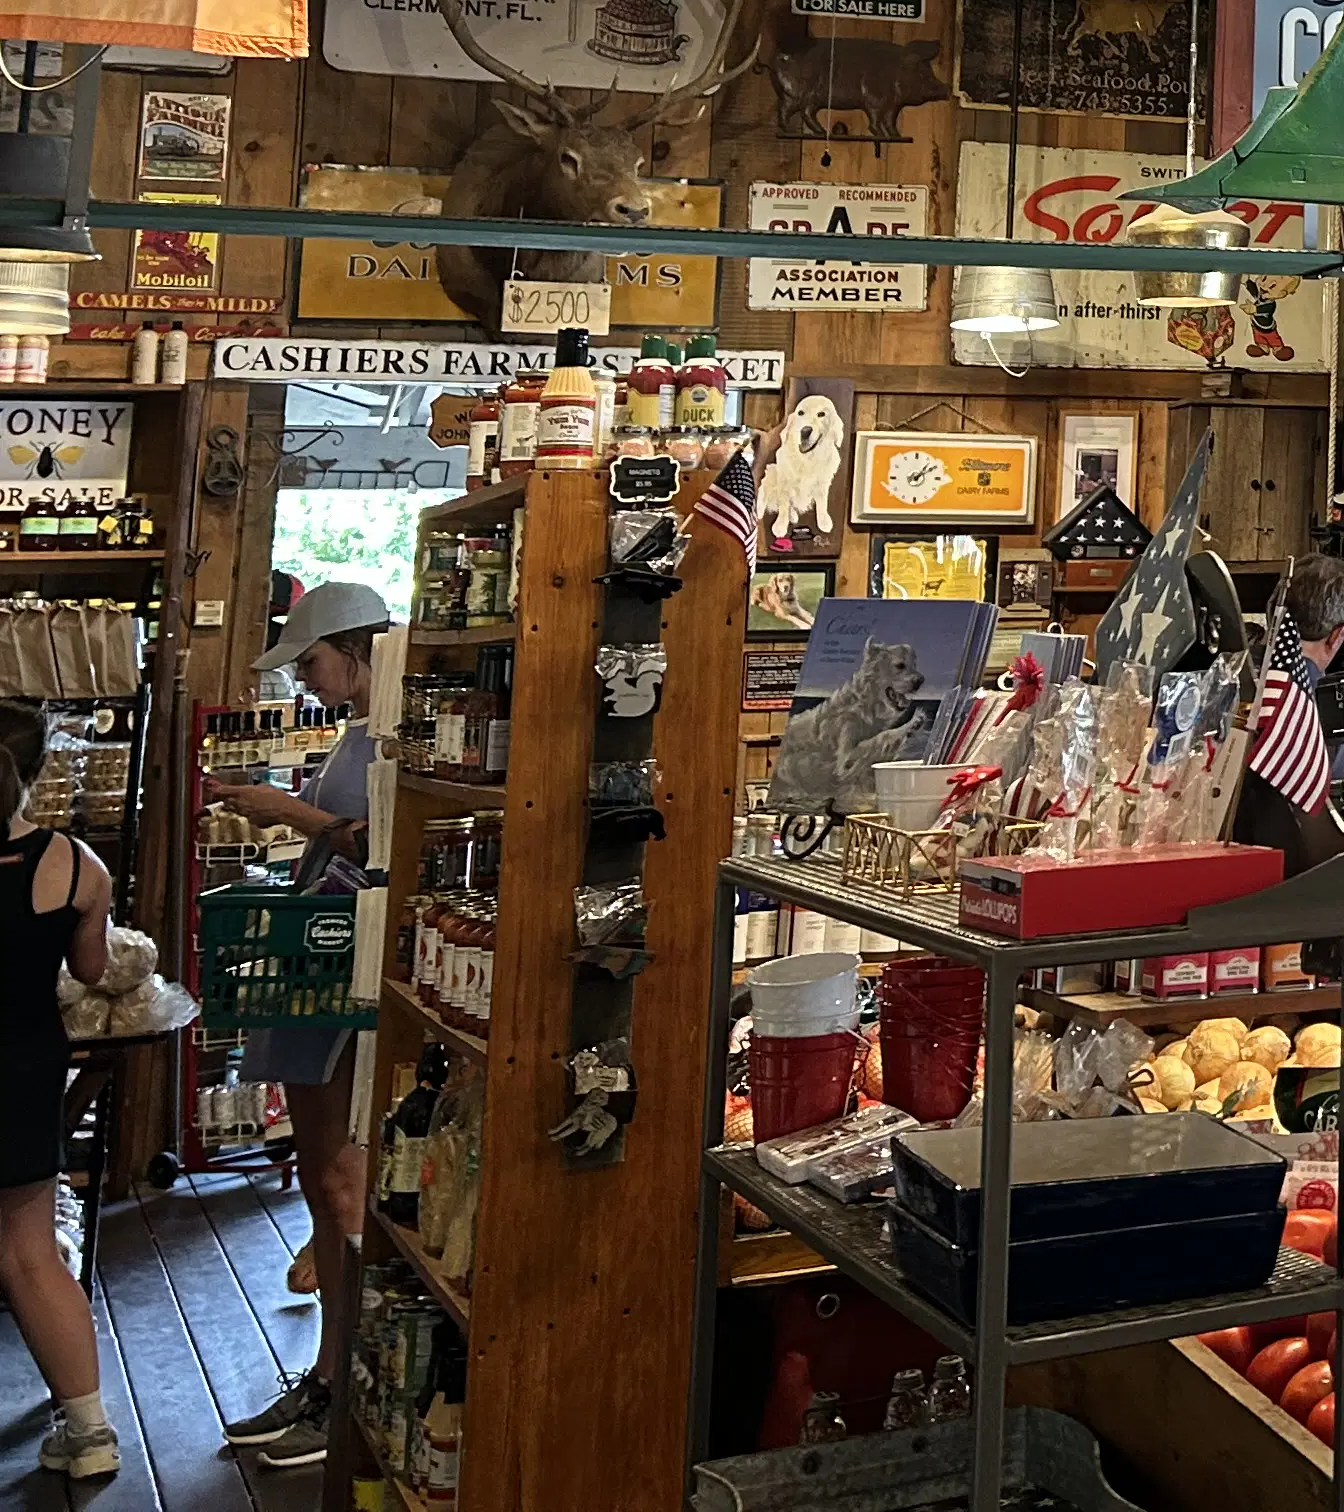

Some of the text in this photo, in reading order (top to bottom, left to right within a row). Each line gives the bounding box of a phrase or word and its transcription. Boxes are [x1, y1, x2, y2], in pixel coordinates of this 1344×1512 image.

[838, 0, 874, 14] SALE
[878, 2, 915, 17] HERE
[1140, 167, 1188, 179] SWIT
[762, 188, 917, 202] APPROVED RECOMMENDED
[348, 254, 431, 281] DAI
[137, 272, 209, 287] Mobiloil
[776, 269, 899, 283] ASSOCIATION
[76, 292, 174, 310] CAMELS
[206, 299, 276, 313] MILD!
[771, 287, 902, 302] MEMBER
[508, 287, 590, 324] $2500
[1075, 303, 1161, 319] after-thirst
[222, 344, 619, 377] CASHIERS FARMRS
[683, 408, 715, 423] DUCK
[0, 407, 125, 446] ONEY
